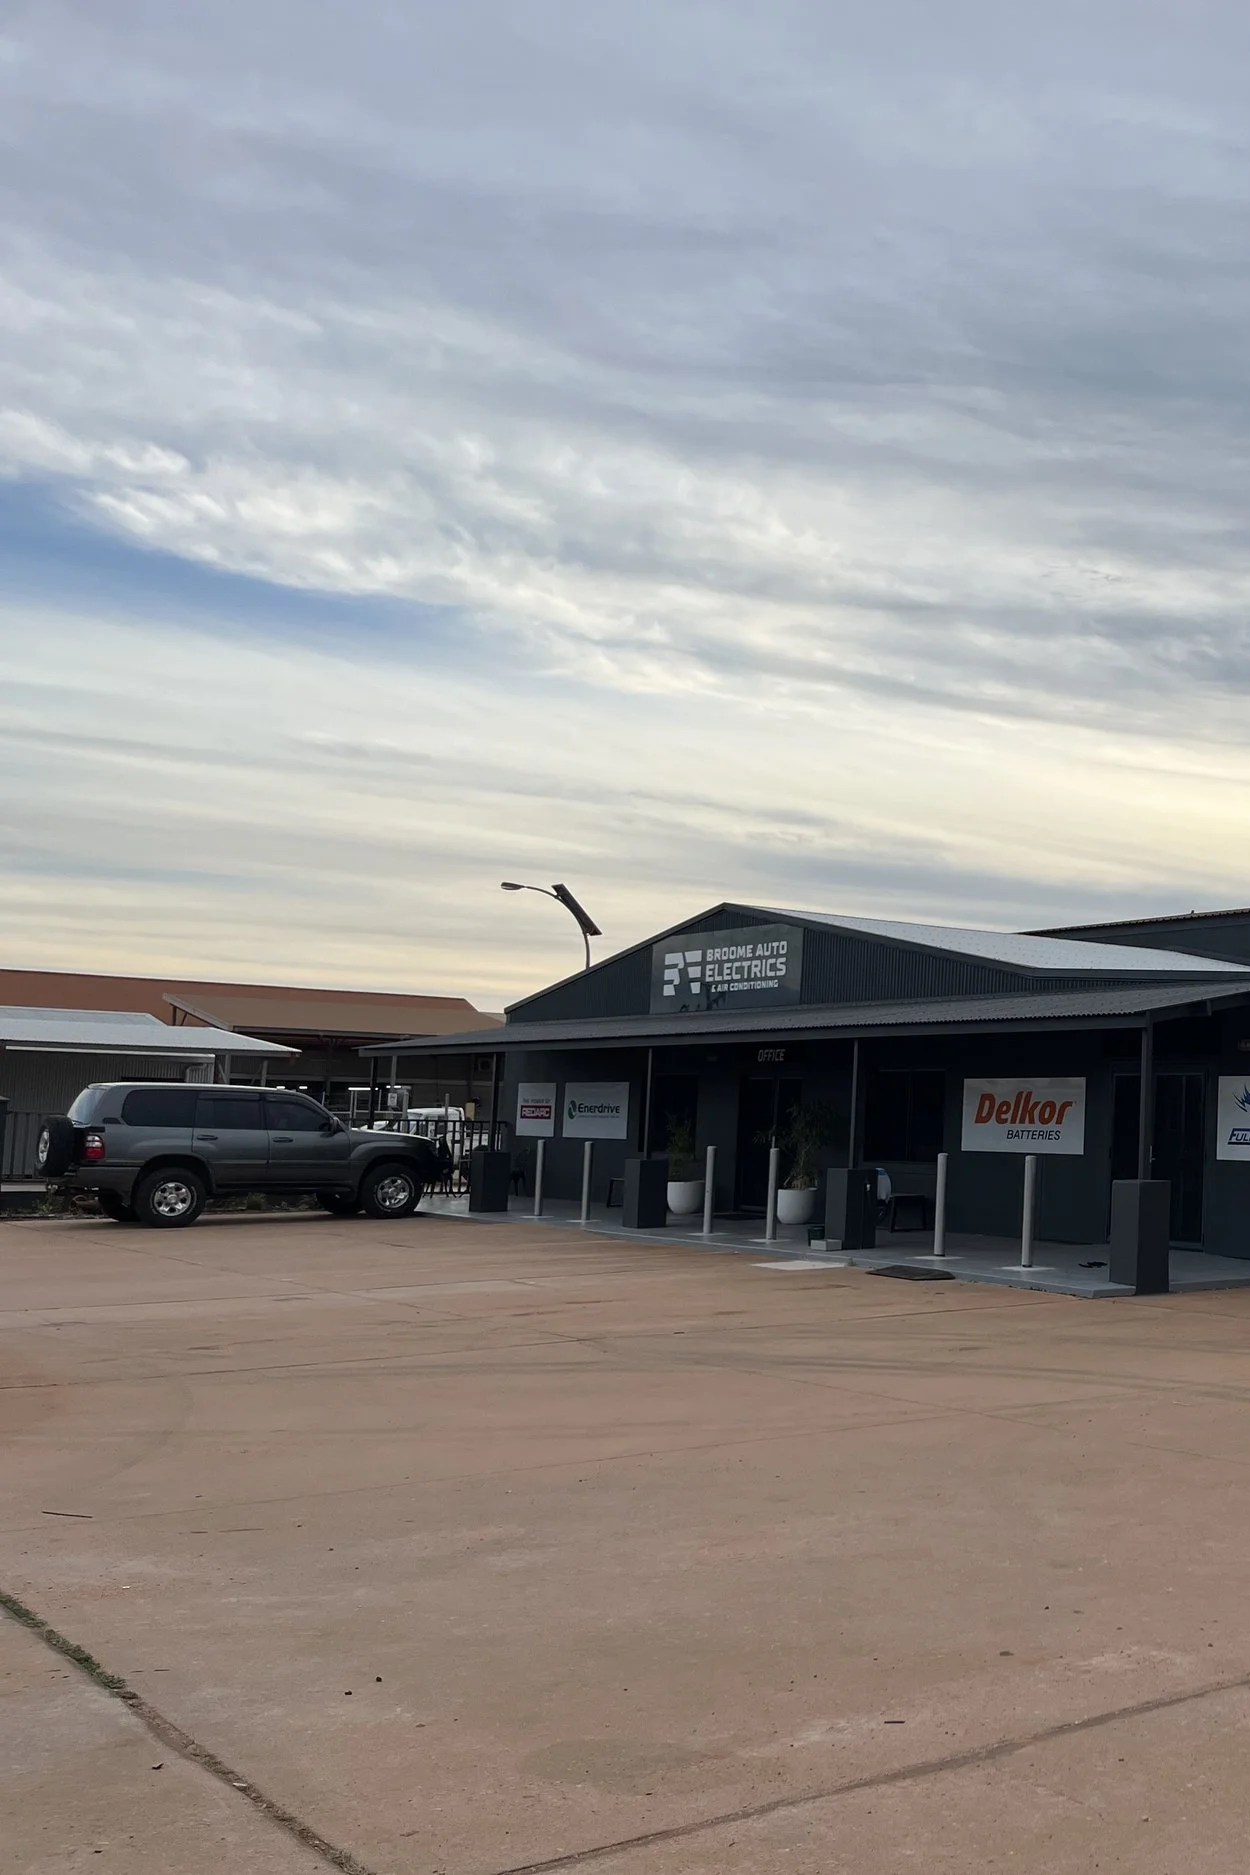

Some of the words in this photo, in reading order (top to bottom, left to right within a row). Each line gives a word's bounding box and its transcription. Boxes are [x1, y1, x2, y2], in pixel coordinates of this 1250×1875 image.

[706, 944, 754, 962] BROOME
[755, 941, 788, 957] AUTO
[705, 957, 787, 982] ELECTRICS
[717, 983, 729, 992] AIR
[729, 979, 779, 992] CONDITIONING
[757, 1048, 786, 1062] OFFICE
[522, 1107, 550, 1117] REDARC
[578, 1102, 620, 1114] Enerdrive
[974, 1090, 1073, 1125] Delkor
[1006, 1129, 1061, 1141] BATTERIES
